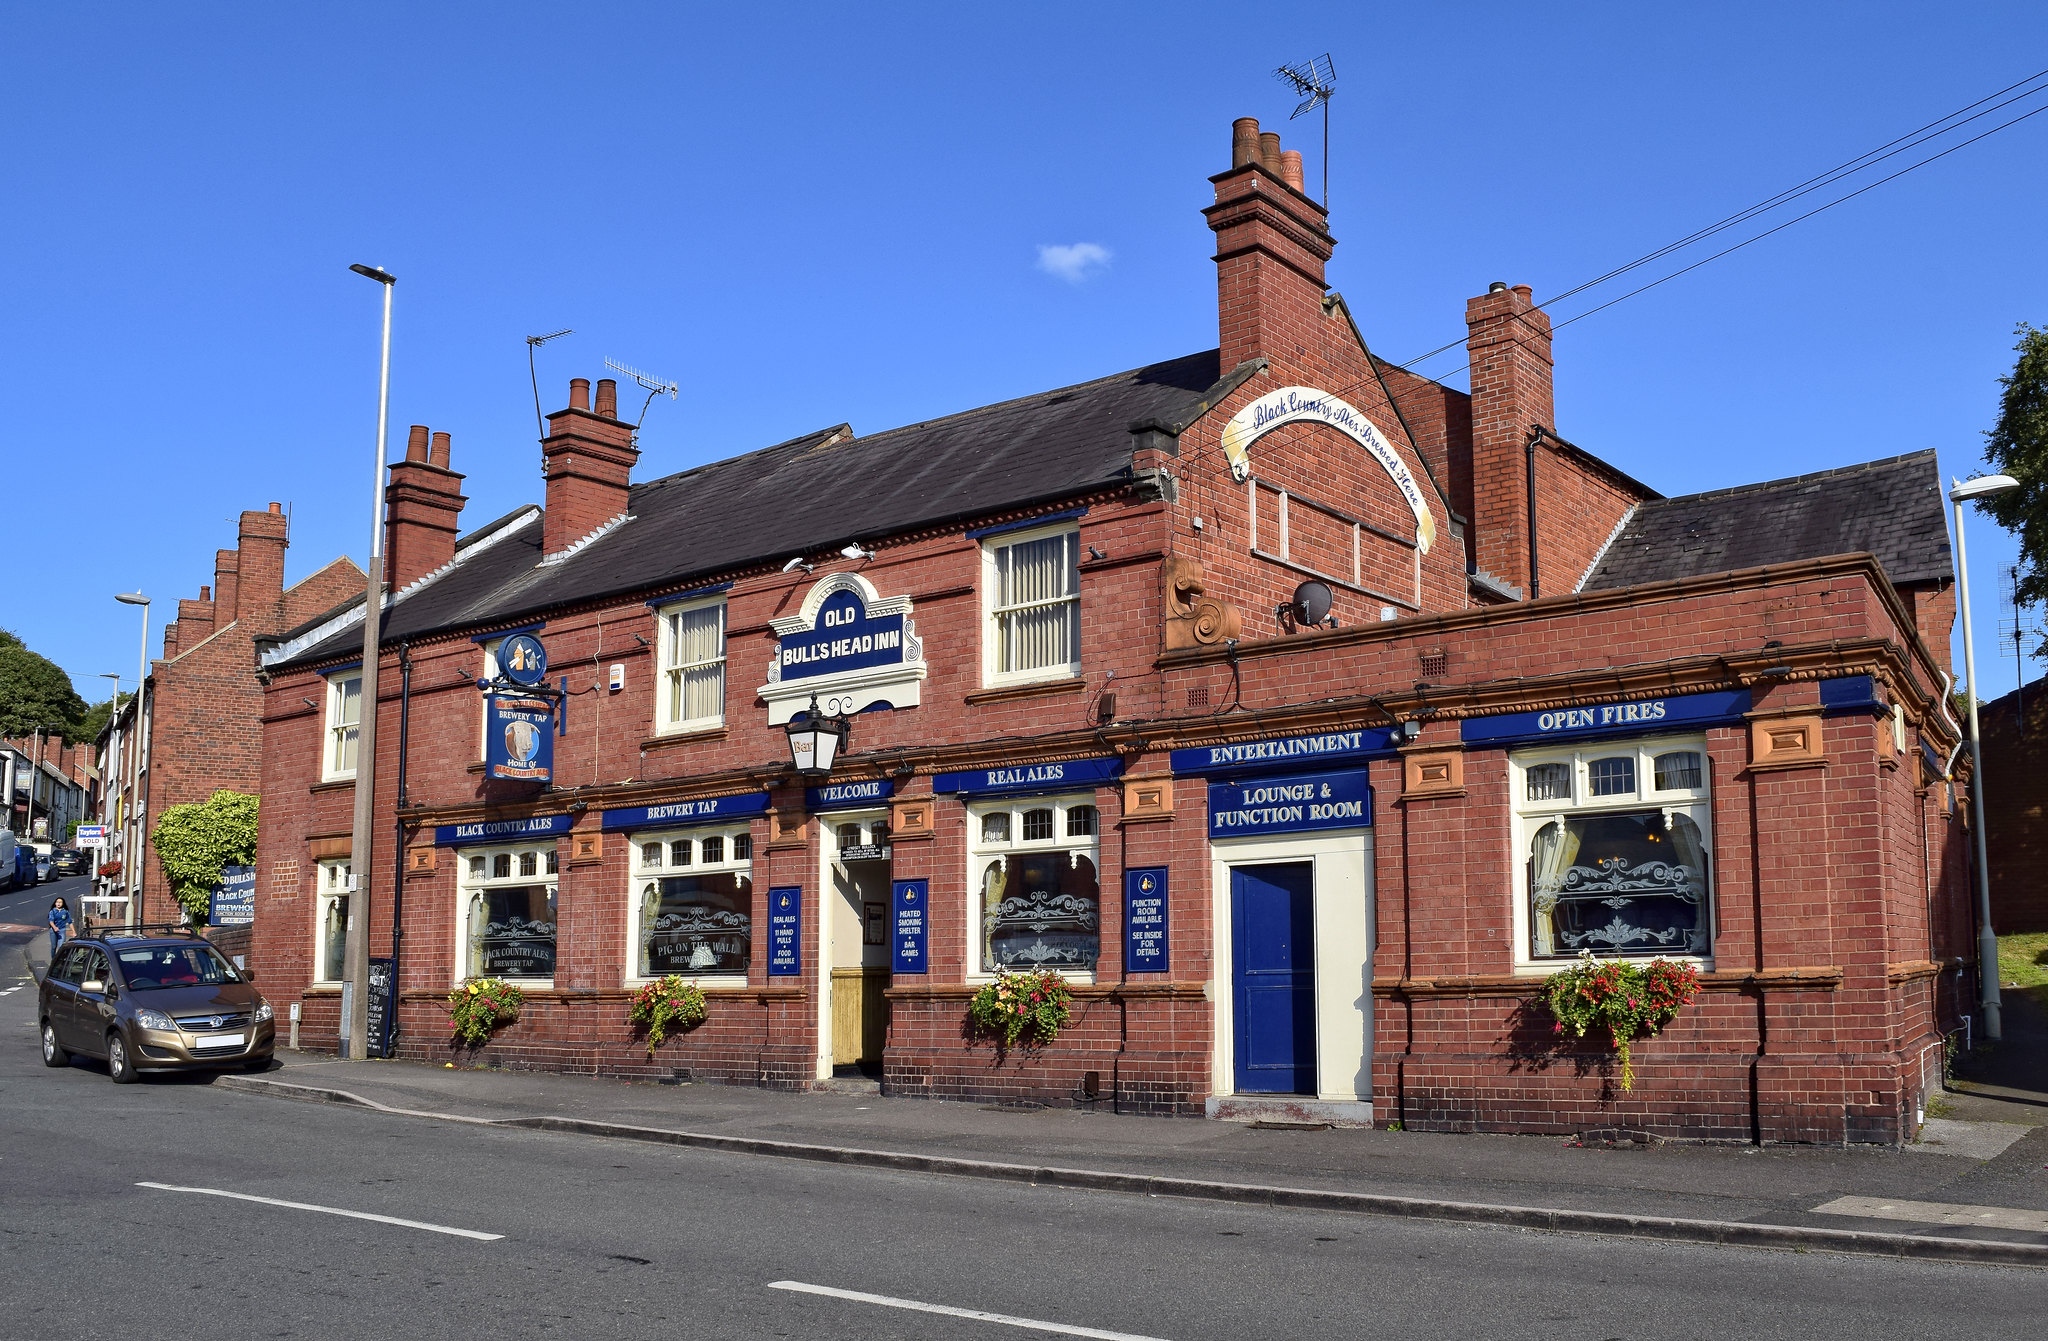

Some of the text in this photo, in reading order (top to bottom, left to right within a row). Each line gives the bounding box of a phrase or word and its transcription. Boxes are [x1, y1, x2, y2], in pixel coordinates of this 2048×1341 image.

[1254, 391, 1418, 506] Black Country Ales Brewed Here
[825, 606, 855, 628] OLD
[782, 630, 899, 666] BULL'S HEAD INN
[499, 710, 547, 722] BREWERY TAP
[1537, 701, 1666, 731] OPEN FIRES
[793, 741, 813, 753] Bar
[1209, 732, 1362, 764] ENTERTAINMENT
[987, 765, 1064, 786] REAL ALES
[818, 782, 880, 801] WELCOME
[1242, 782, 1331, 805] LOUNGE &
[647, 800, 718, 819] BREWERY TAP
[1214, 801, 1362, 828] FUNCTION ROOM
[456, 817, 552, 837] BLACK COUNTRY ALES
[216, 890, 238, 901] BLACK
[1132, 898, 1161, 908] FUNCTION
[899, 910, 921, 918] HEATED
[1137, 907, 1157, 916] ROOM
[773, 915, 796, 924] REAL ALES
[898, 918, 922, 927] SMOKING
[1132, 915, 1162, 924] AVAILABLE
[780, 928, 794, 936] HAND
[898, 927, 921, 935] SHELTER
[1132, 930, 1163, 940] SEE INSIDE
[904, 941, 915, 949] BAR
[1140, 939, 1155, 948] FOR
[501, 947, 532, 957] COUNTRY
[532, 948, 549, 960] ALES
[657, 945, 673, 956] PIG
[675, 943, 688, 952] ON
[712, 942, 737, 954] WALL
[777, 949, 791, 957] FOOD
[901, 949, 919, 957] GAMES
[1136, 948, 1160, 956] DETAILS
[493, 959, 534, 968] BREWERY TAP
[773, 957, 795, 965] AVAILABLE
